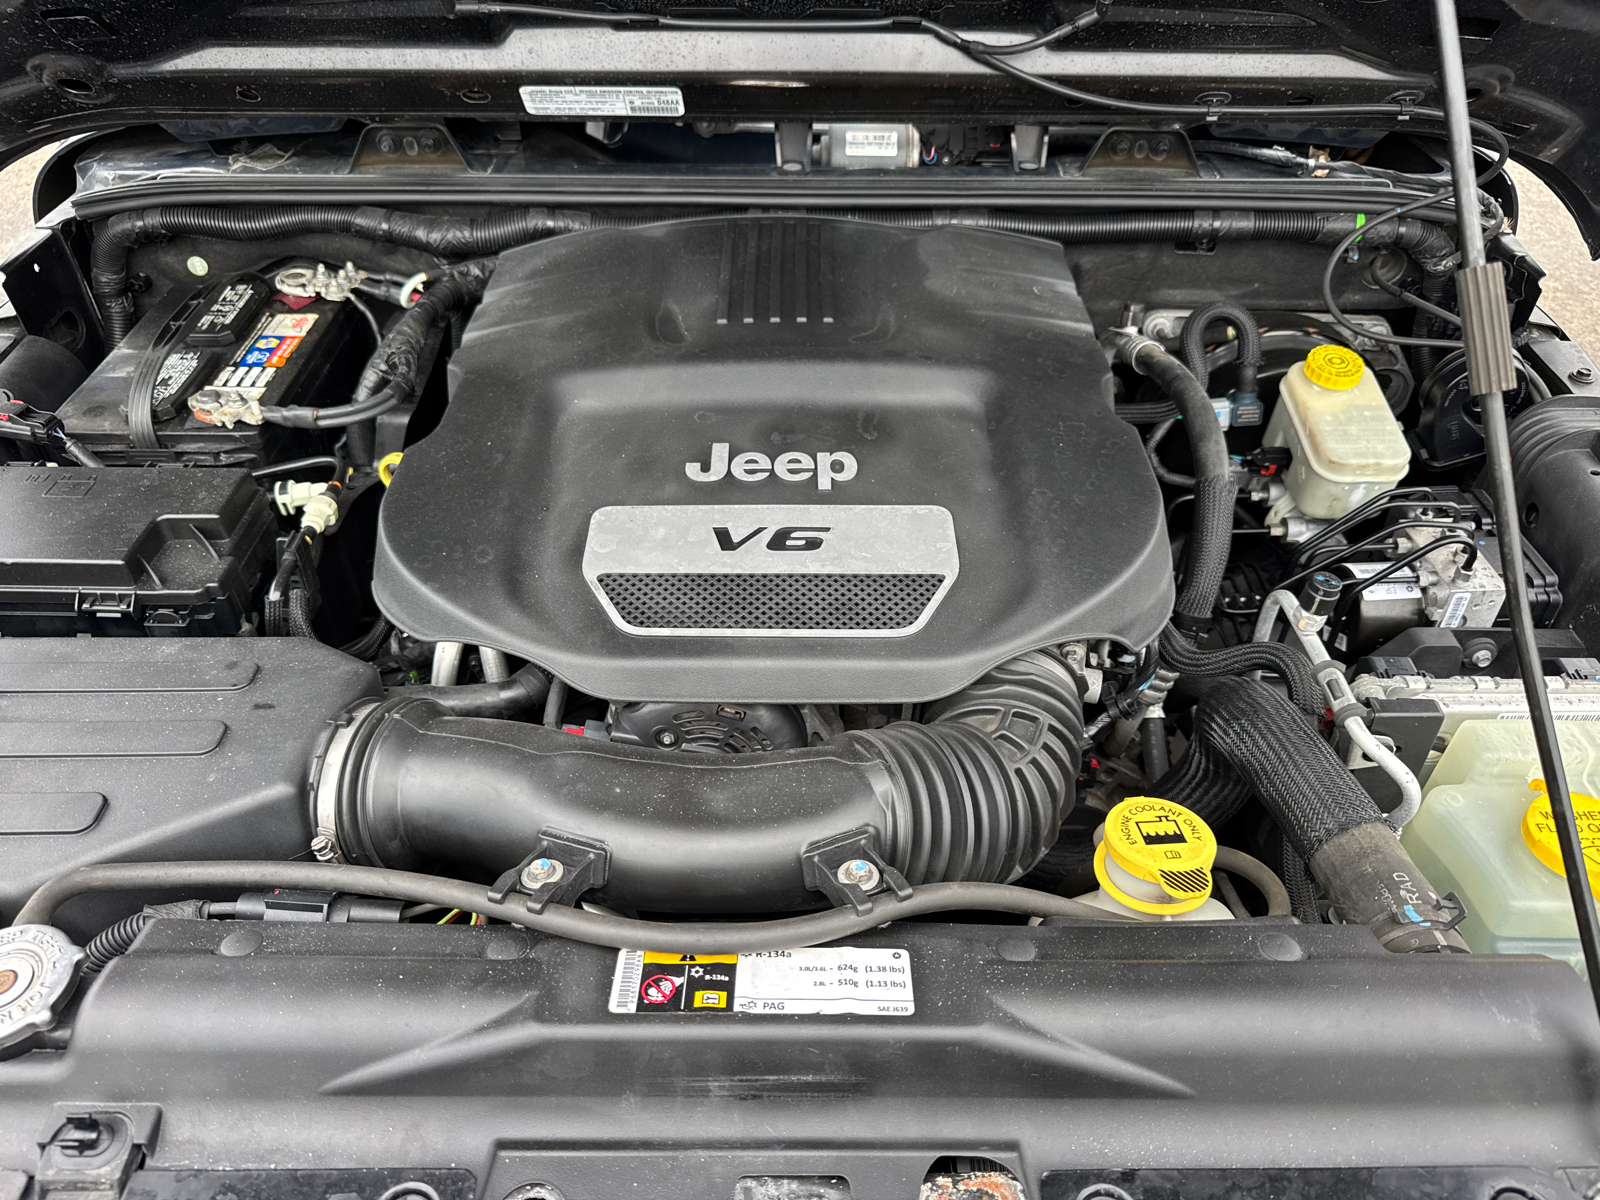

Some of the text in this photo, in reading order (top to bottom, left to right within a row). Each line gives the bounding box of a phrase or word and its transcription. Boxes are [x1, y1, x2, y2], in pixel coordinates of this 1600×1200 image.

[685, 442, 858, 491] Jeep
[712, 526, 832, 552] V6
[1120, 804, 1203, 846] ENGINE COOLANT ONLY
[1392, 872, 1423, 904] RAD
[704, 974, 730, 982] R-134a
[837, 964, 859, 974] 624g
[864, 965, 888, 974] (1.38
[889, 965, 905, 975] lbs)
[837, 978, 859, 988] 510g
[865, 979, 889, 989] (1.13
[890, 980, 907, 989] lbs)
[762, 1001, 786, 1011] PAG
